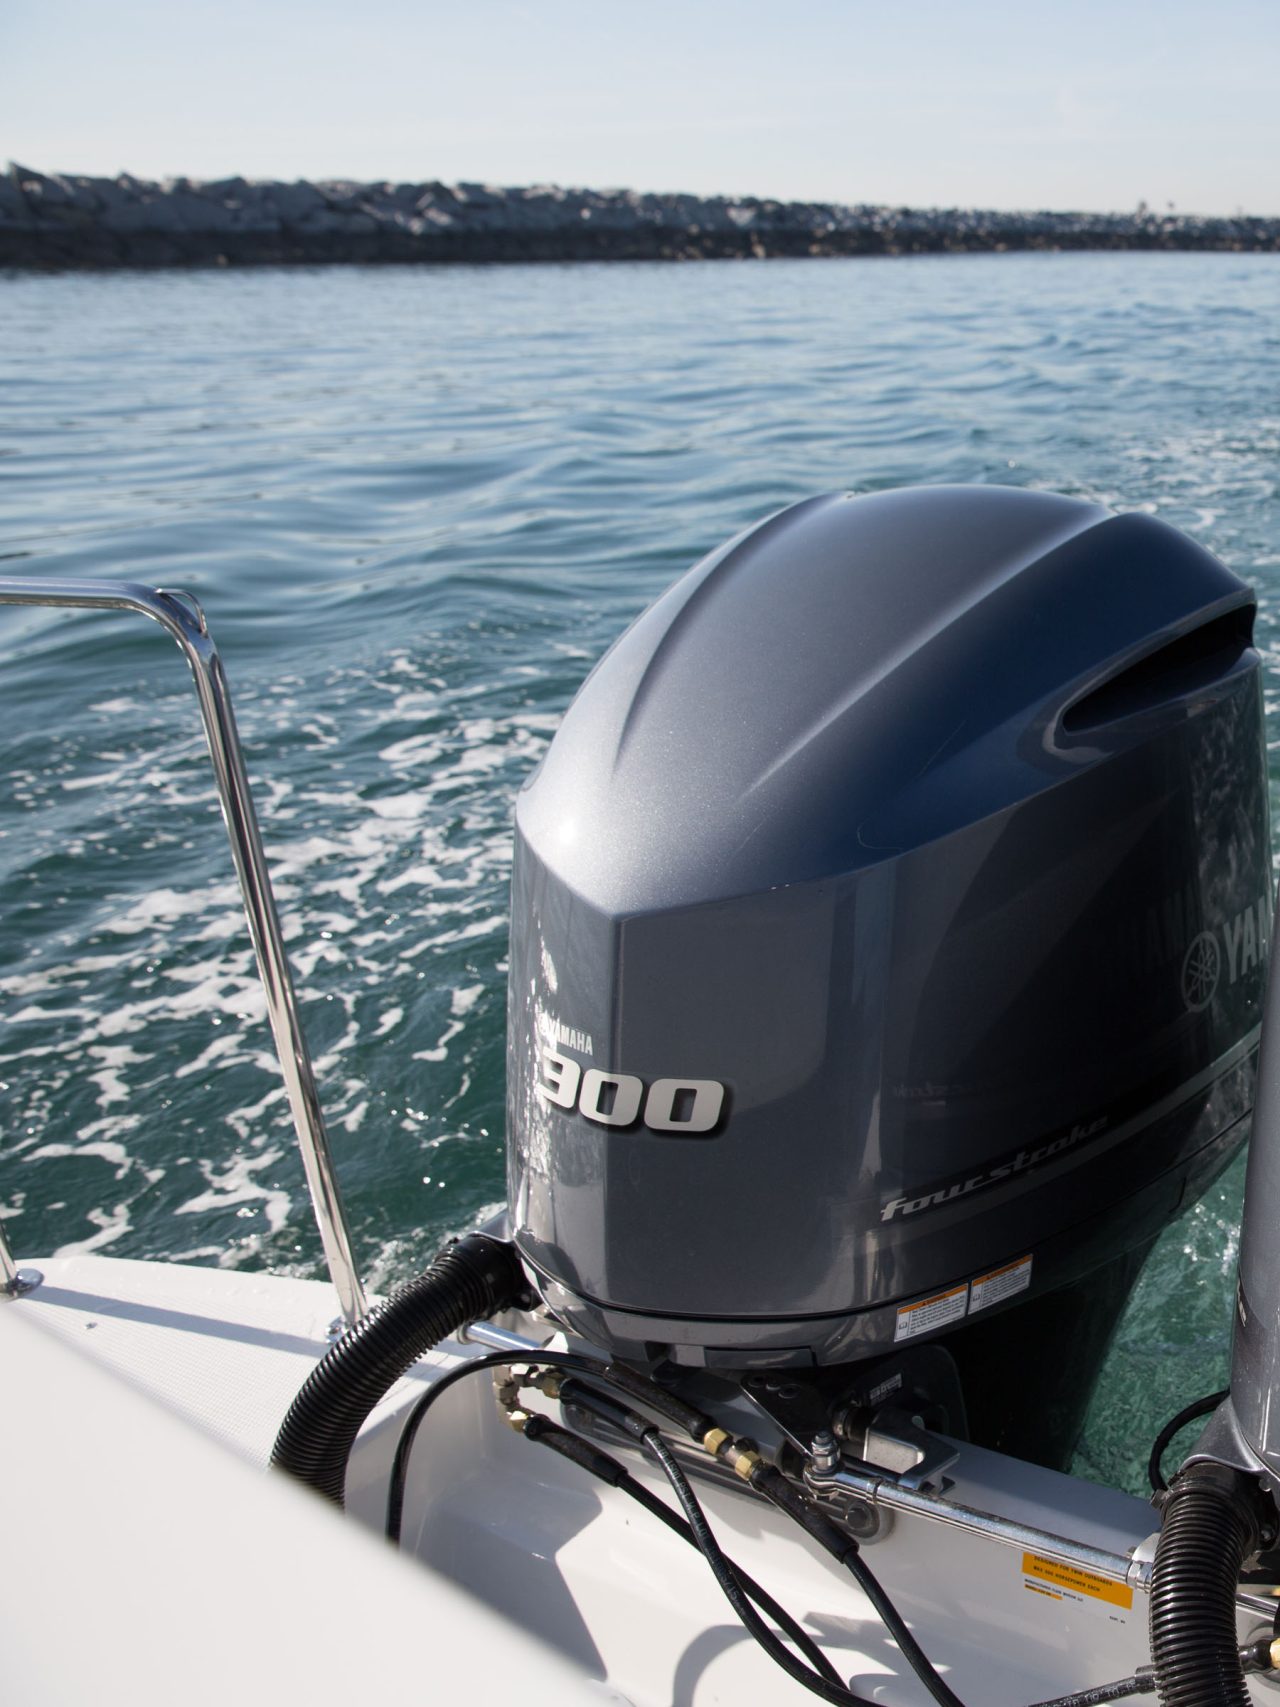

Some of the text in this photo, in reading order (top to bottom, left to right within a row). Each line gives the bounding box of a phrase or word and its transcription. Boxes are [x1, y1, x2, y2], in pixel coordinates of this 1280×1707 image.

[1223, 896, 1270, 984] YAM
[536, 1046, 725, 1133] 300
[880, 1116, 1108, 1221] fourstroke
